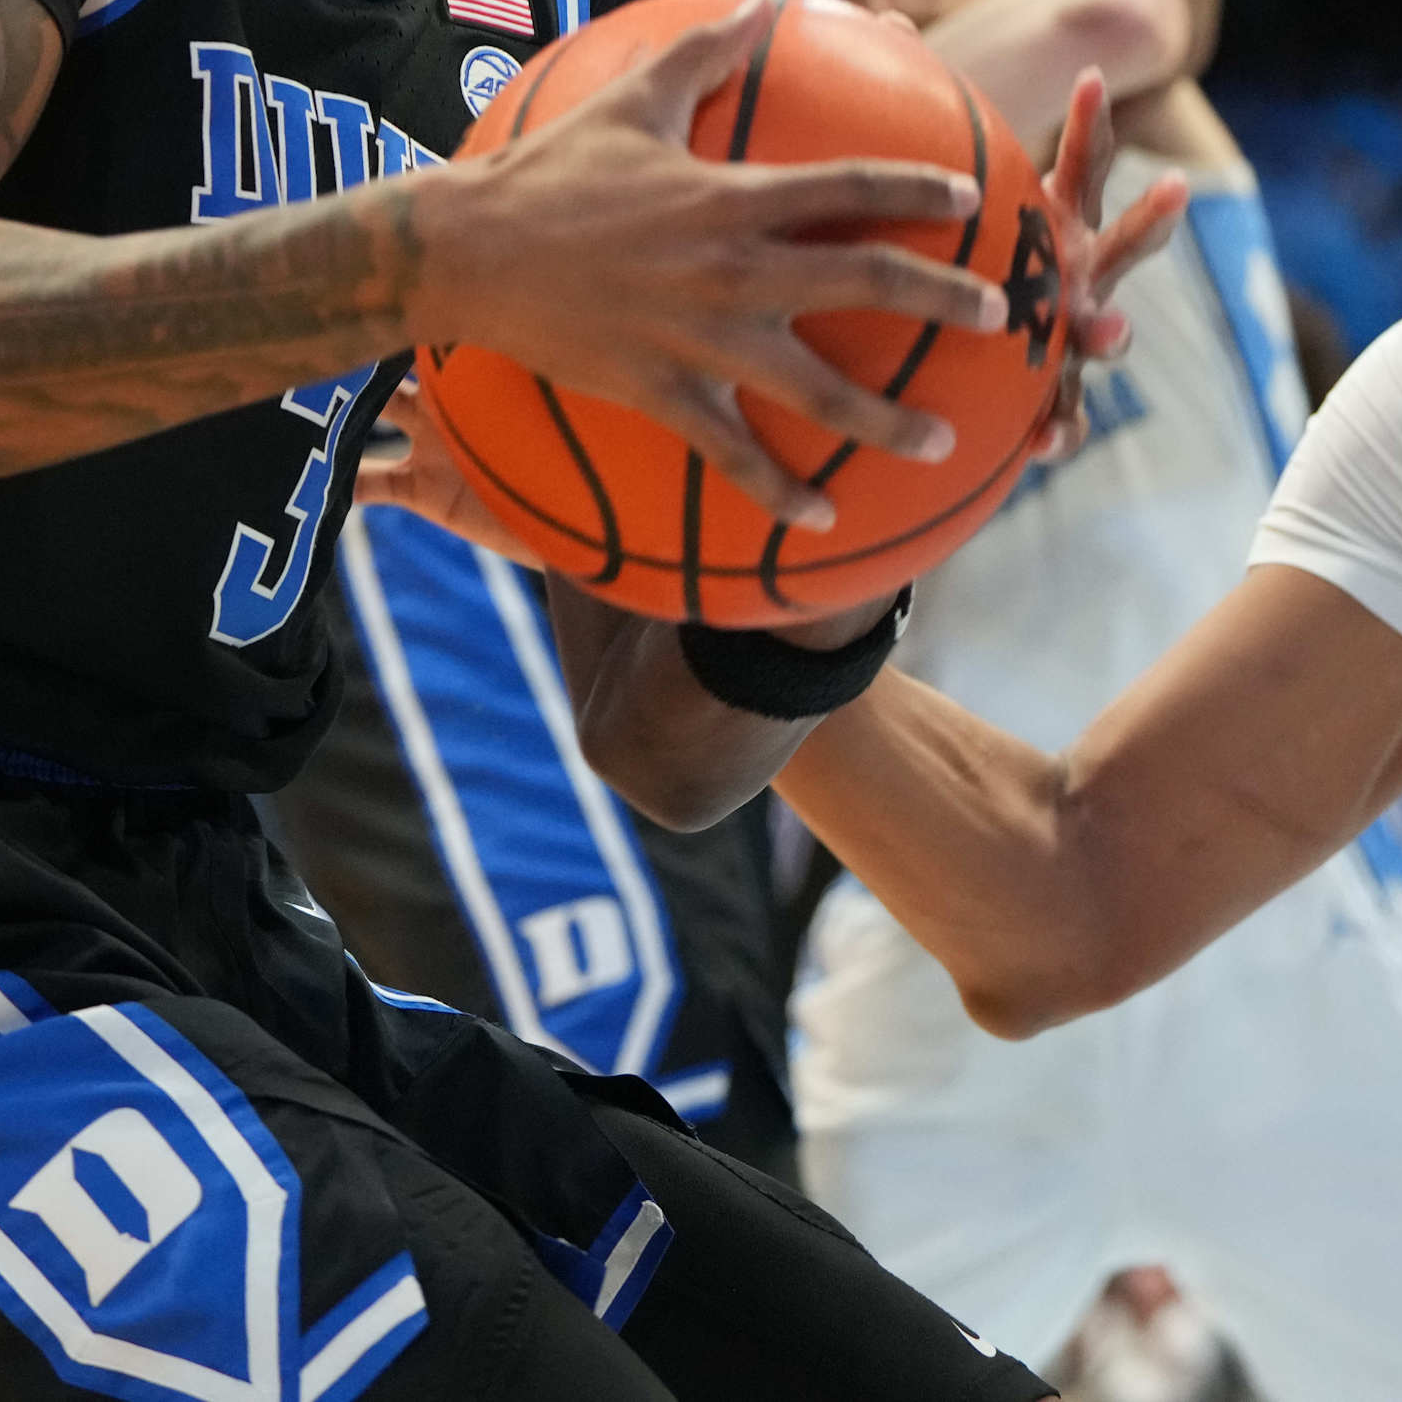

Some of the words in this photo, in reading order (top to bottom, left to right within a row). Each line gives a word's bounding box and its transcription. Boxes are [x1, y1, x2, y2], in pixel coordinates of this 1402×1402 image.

[208, 360, 381, 648] 3
[518, 895, 636, 1009] D
[8, 1106, 203, 1308] D
